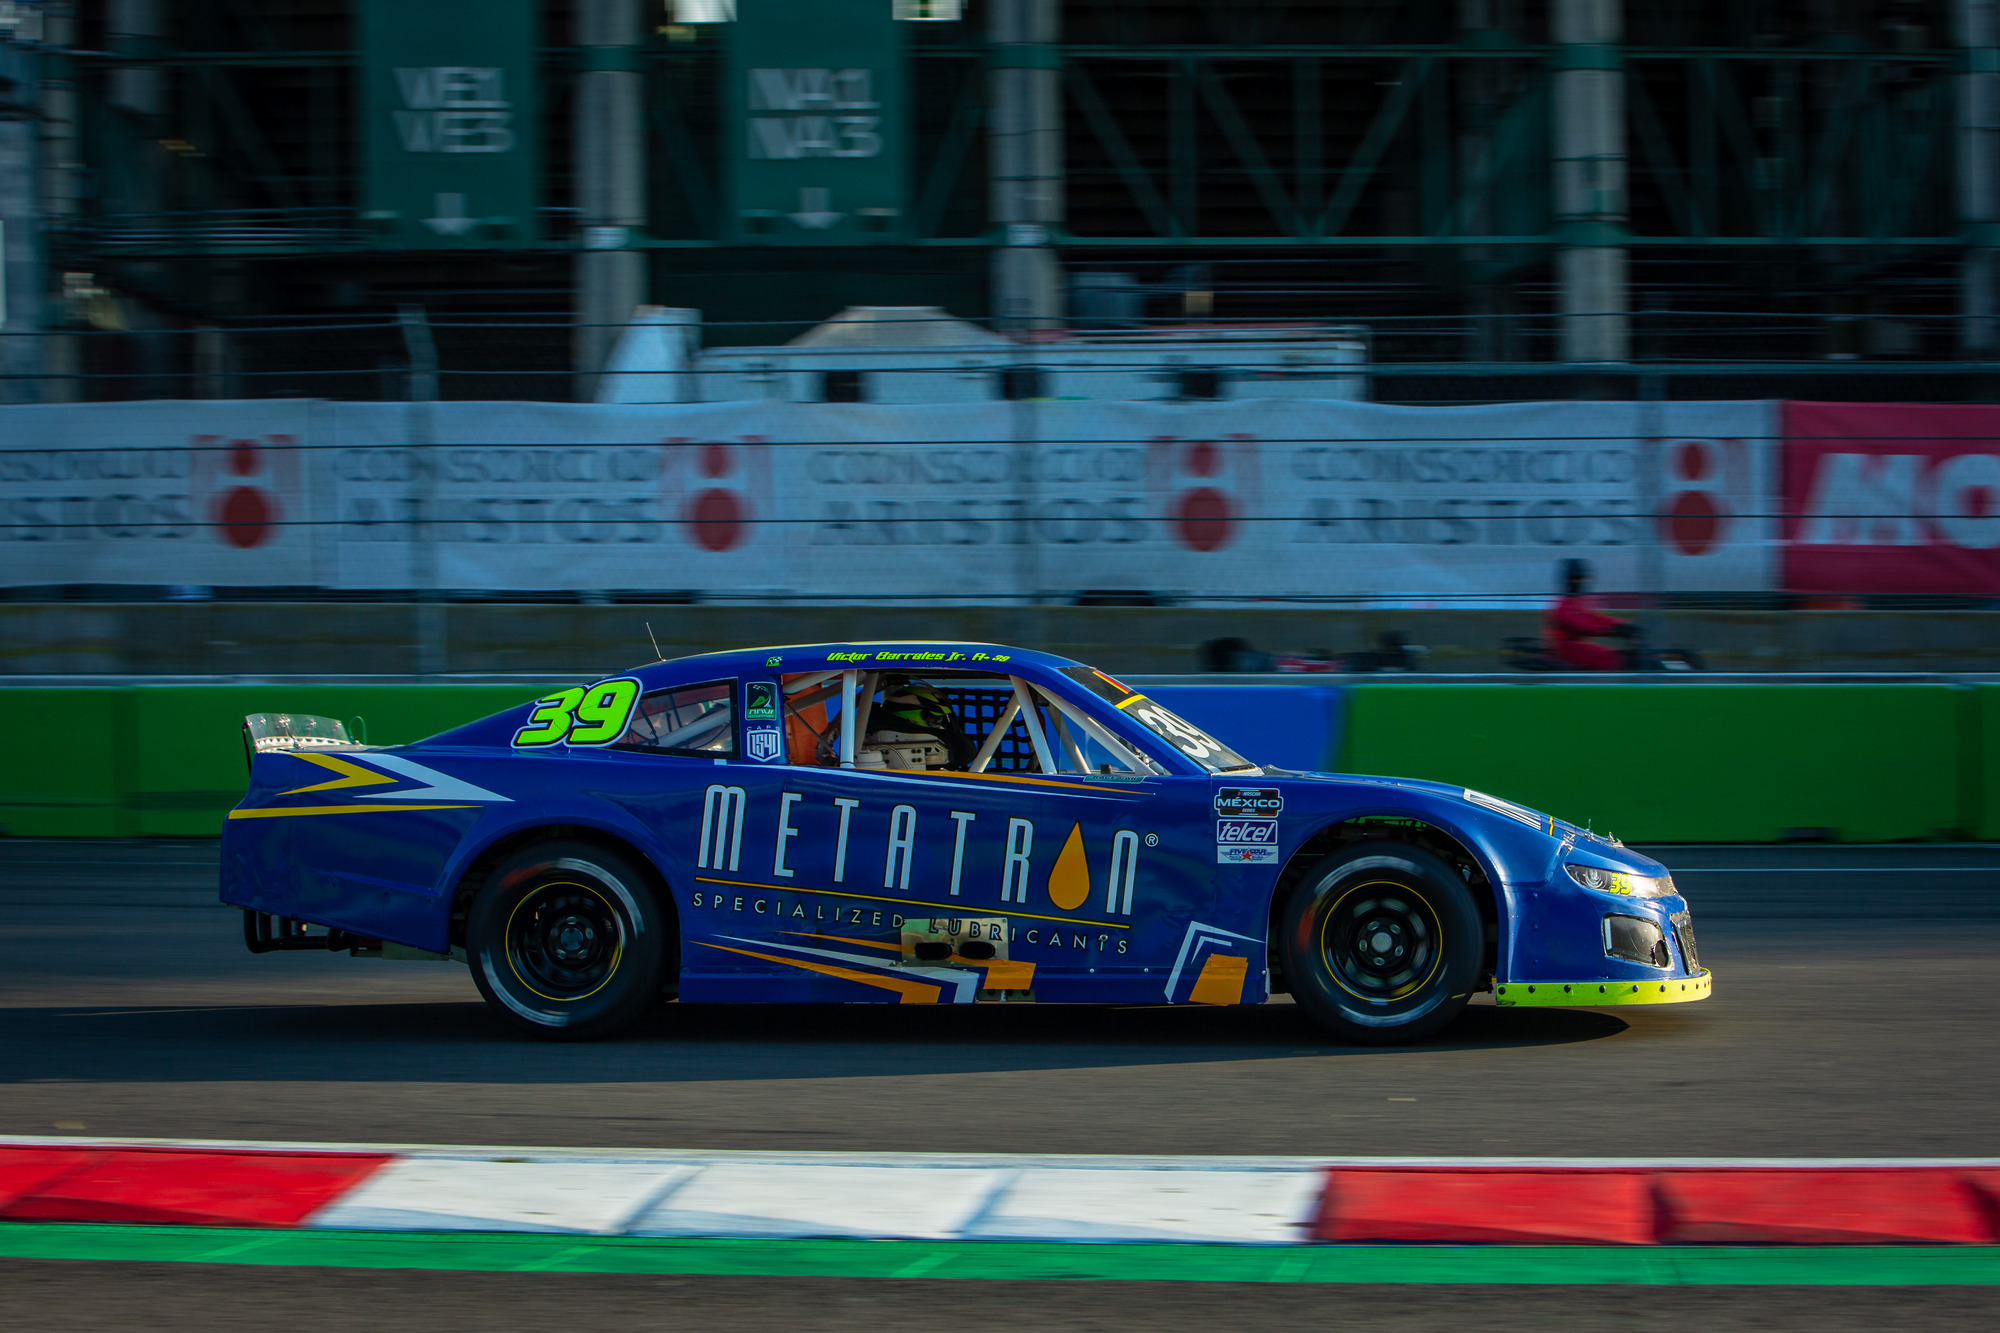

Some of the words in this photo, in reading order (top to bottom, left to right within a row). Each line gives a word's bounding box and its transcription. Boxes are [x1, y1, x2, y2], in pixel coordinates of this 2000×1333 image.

[826, 651, 872, 664] Victor
[875, 651, 945, 661] Barrales
[945, 651, 967, 662] Jr.
[511, 677, 642, 748] 39
[1138, 705, 1222, 759] 39
[751, 733, 777, 758] 1541
[1217, 796, 1280, 808] MÉXICO
[1218, 822, 1276, 842] telcel
[1609, 872, 1632, 895] 39
[692, 891, 905, 929] SPECIALIZED
